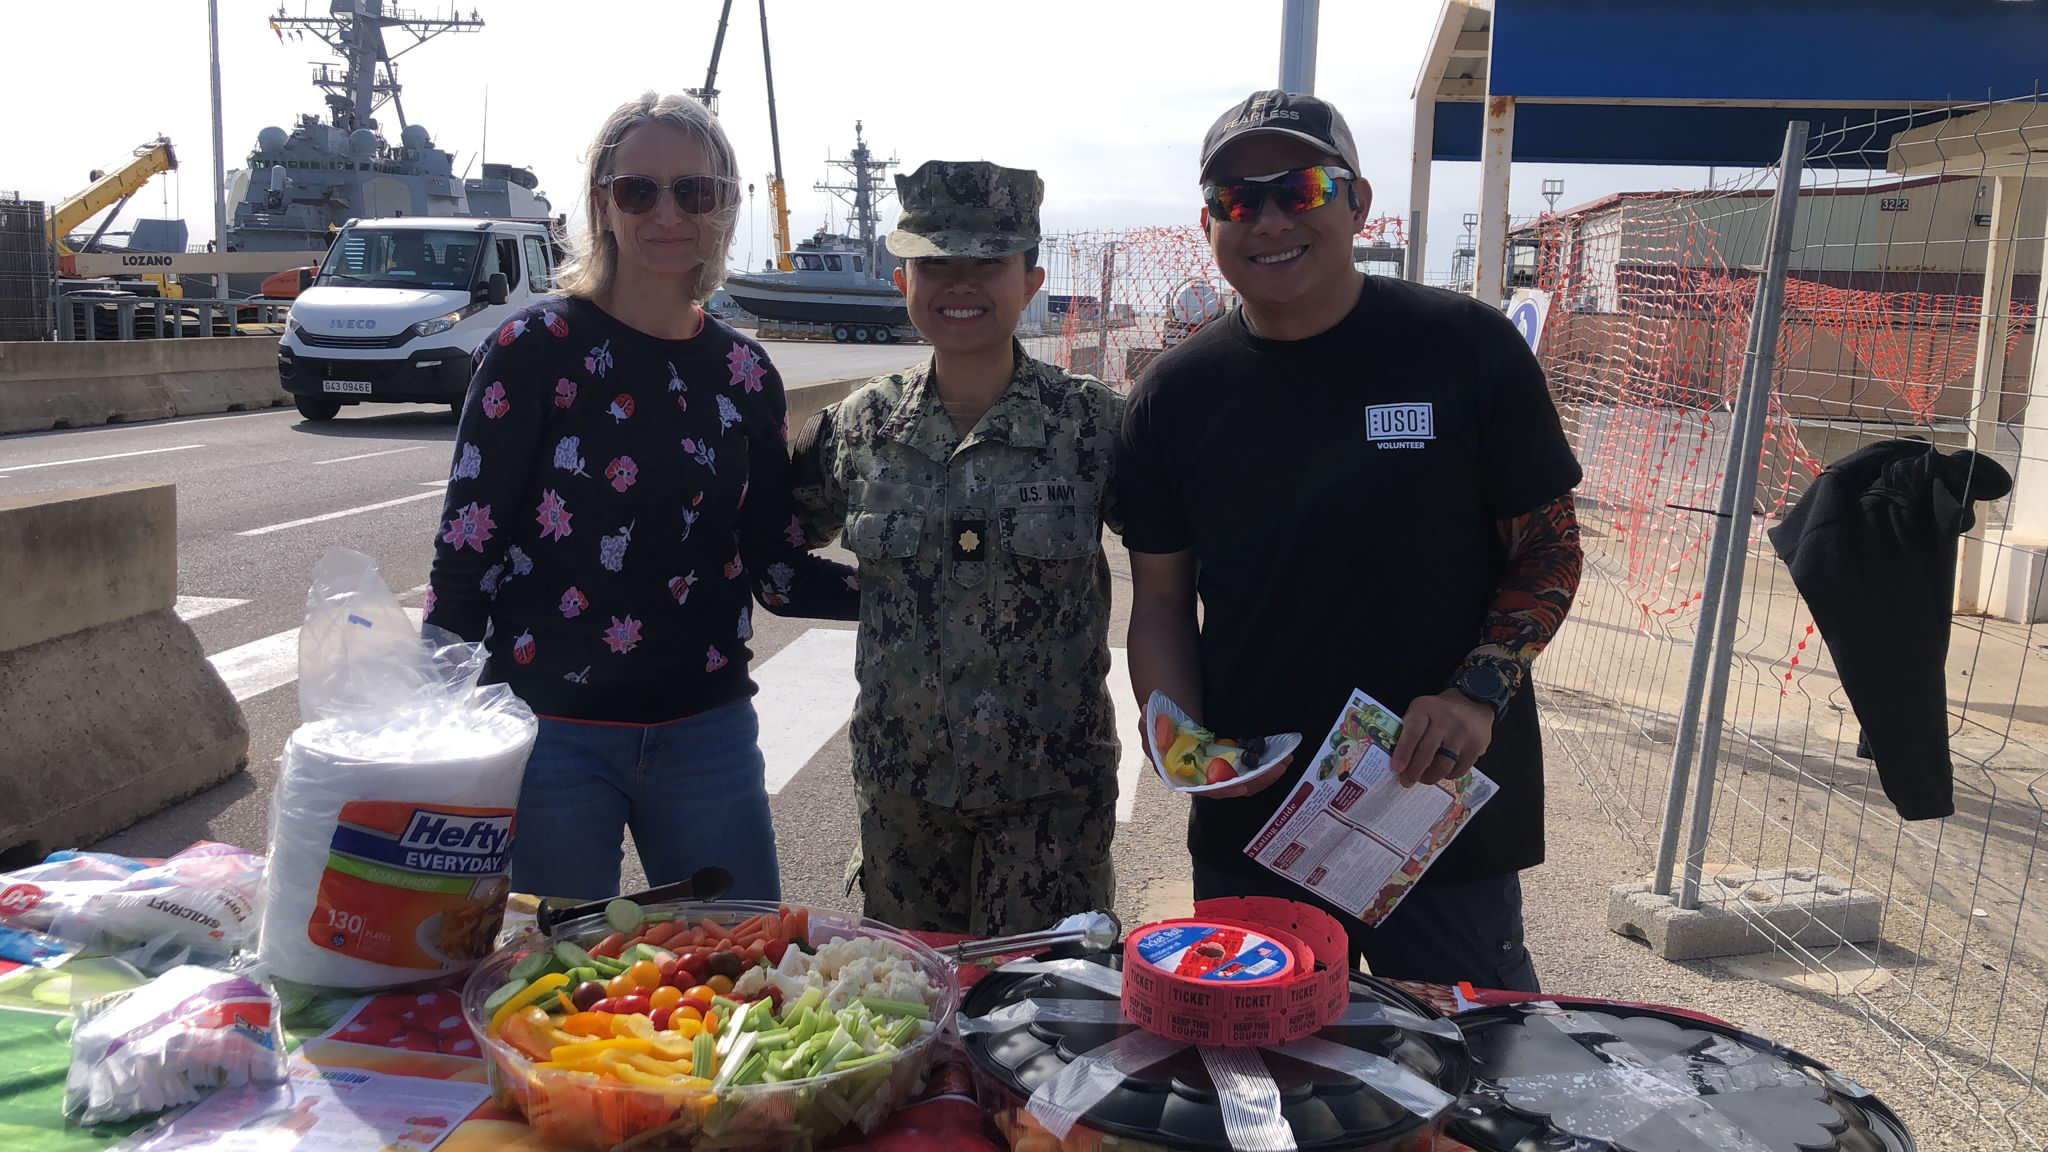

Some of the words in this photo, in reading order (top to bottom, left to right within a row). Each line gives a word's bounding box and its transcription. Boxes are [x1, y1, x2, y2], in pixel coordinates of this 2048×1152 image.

[1223, 110, 1300, 132] FEARLESS
[1882, 199, 1908, 209] 3222
[122, 255, 173, 266] LOZANO
[329, 319, 377, 329] IVECO
[1381, 409, 1418, 433] USO
[1377, 441, 1425, 449] VOLUNTEER
[1019, 486, 1042, 503] U.S.
[1047, 485, 1075, 501] NAVY
[407, 815, 508, 853] Hefty
[405, 851, 502, 872] EVERYDAY
[146, 897, 221, 929] SKILCRAFT
[327, 908, 362, 934] 130
[1130, 967, 1153, 992] TICKET
[1173, 988, 1210, 1006] TICKET
[1233, 995, 1272, 1009] TICKET
[1290, 983, 1317, 1002] TICKET
